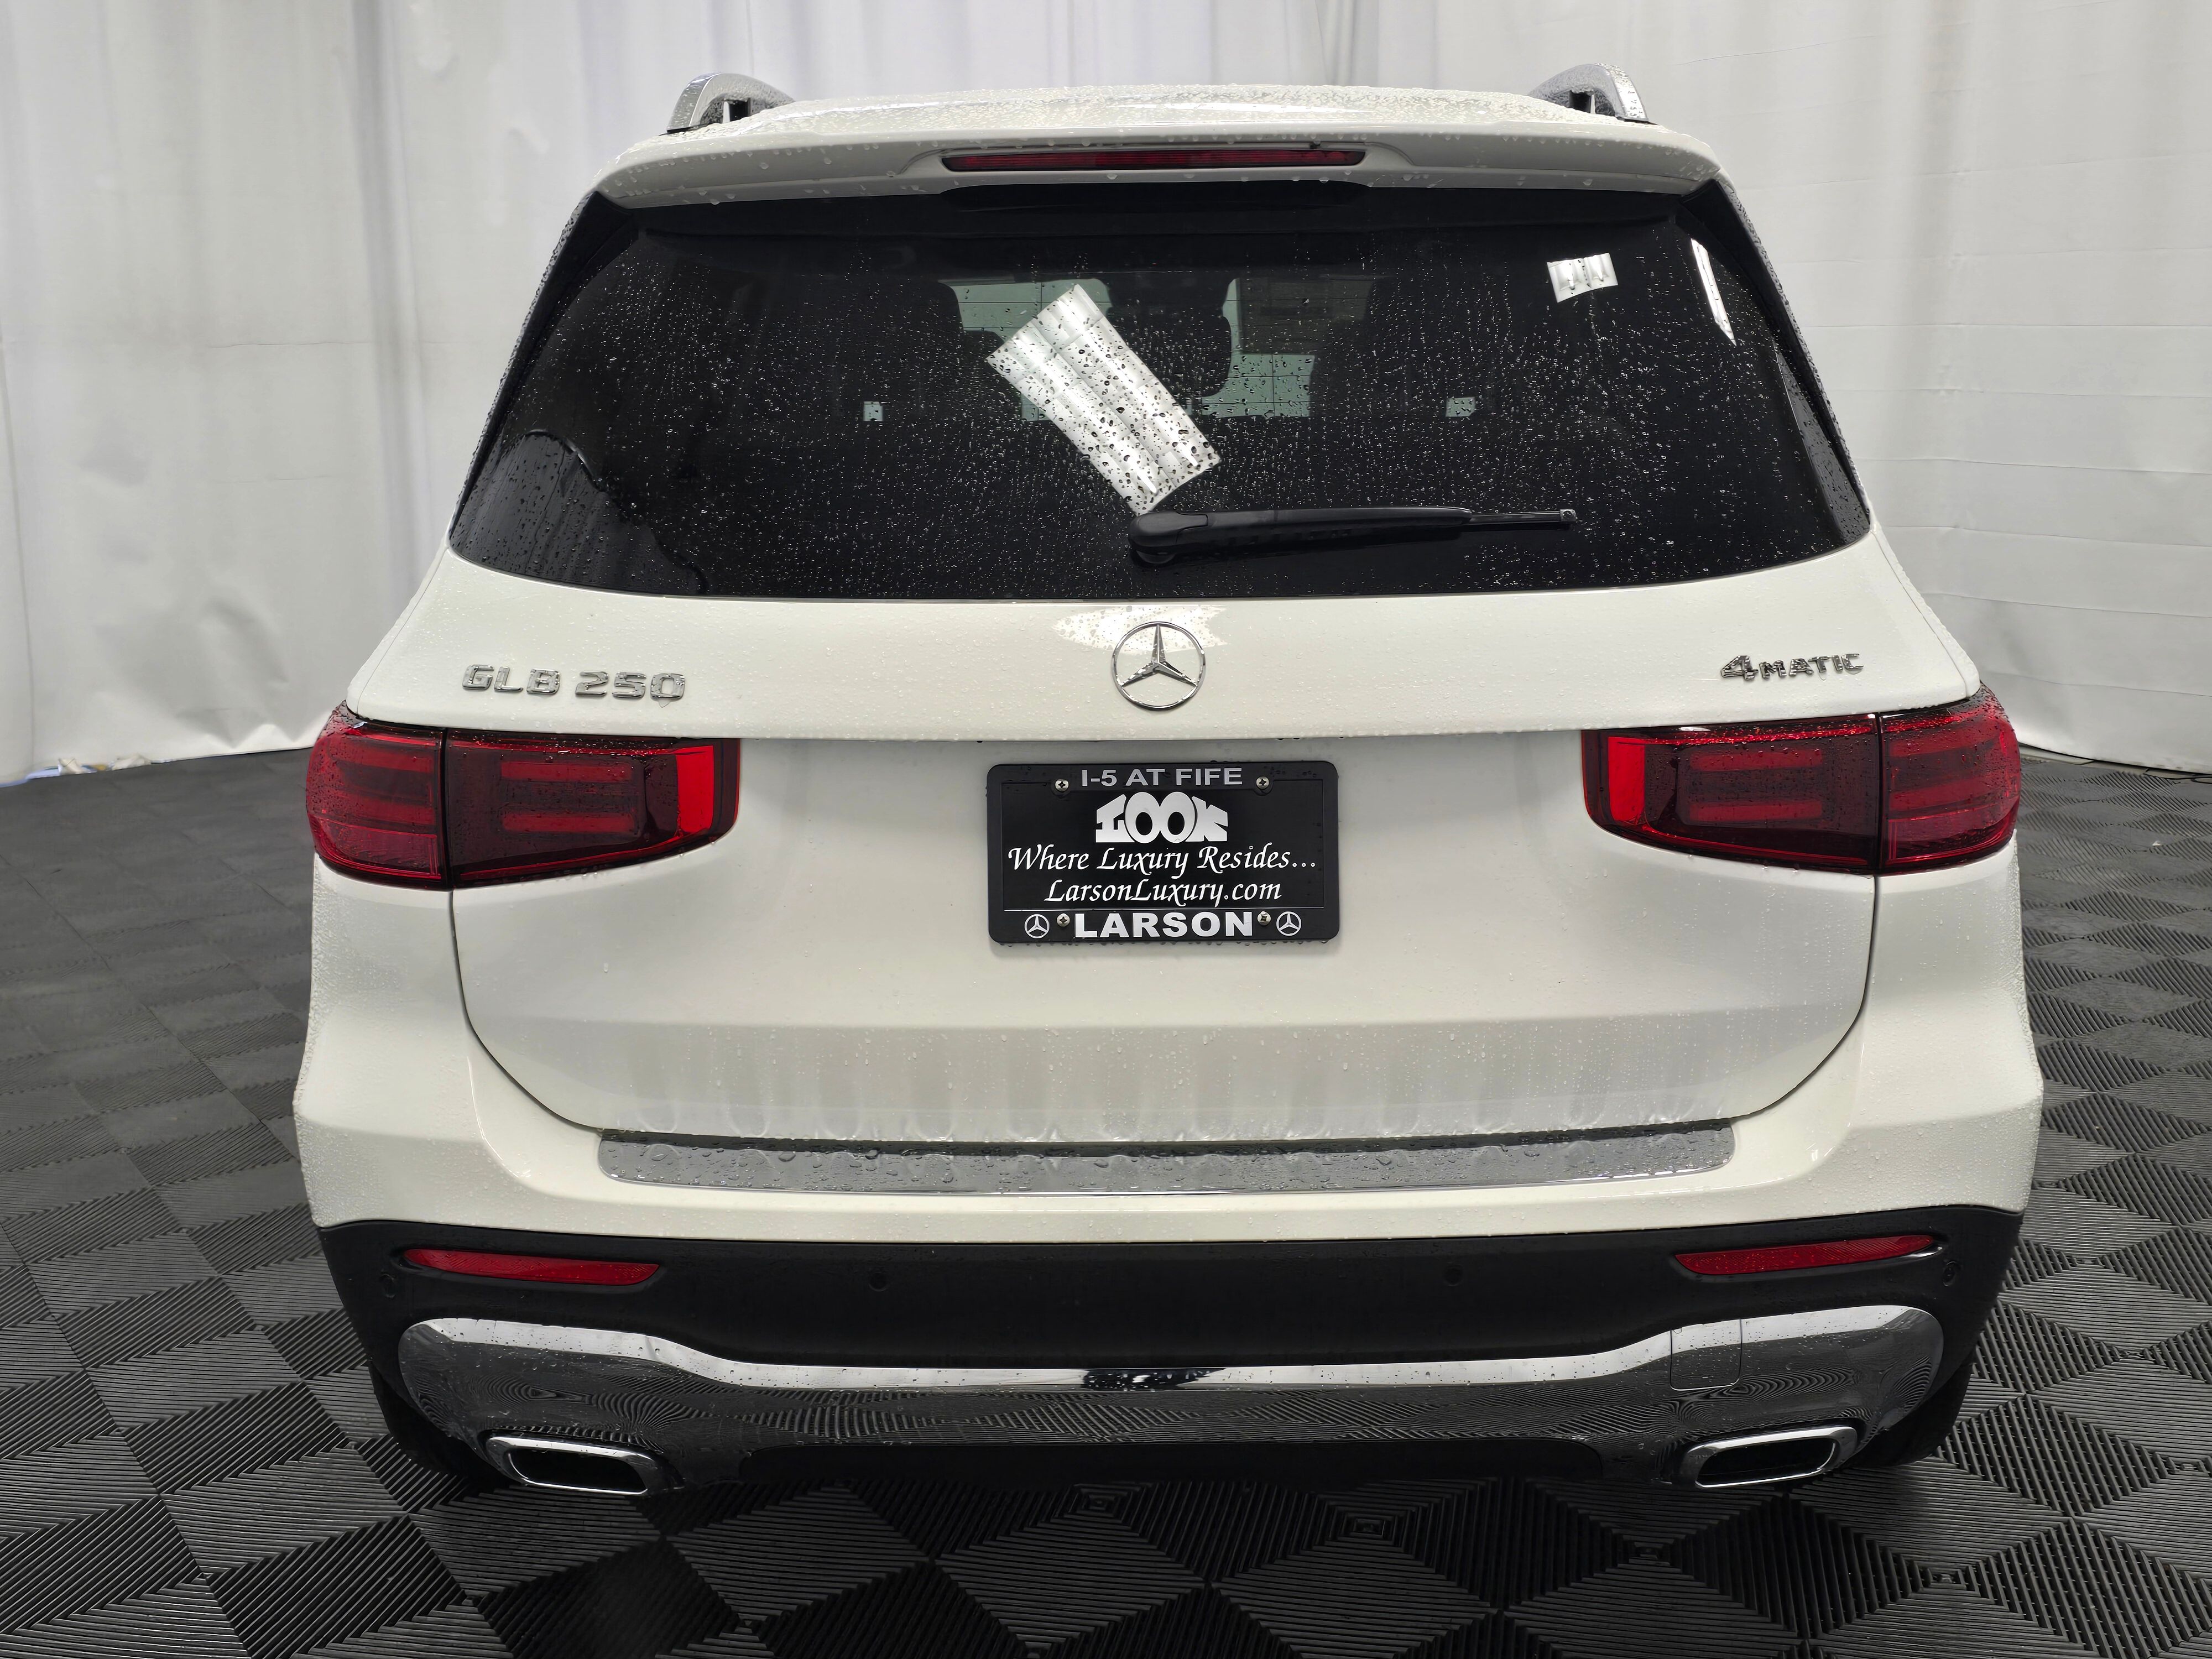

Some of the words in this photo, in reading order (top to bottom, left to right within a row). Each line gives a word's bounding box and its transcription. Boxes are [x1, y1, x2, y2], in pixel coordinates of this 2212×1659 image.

[462, 664, 561, 695] GLB
[575, 671, 686, 699] 250
[1720, 653, 1864, 681] 4MATIC
[1081, 769, 1118, 787] I-5
[1126, 768, 1165, 786] AT
[1176, 768, 1243, 785] FIFE
[1095, 791, 1228, 843] LOOK
[1008, 844, 1089, 870] Where
[1097, 847, 1189, 879] Luxury
[1196, 842, 1316, 873] Resides...
[1044, 878, 1282, 907] LarsonLuxury.com
[1074, 911, 1253, 938] LARSON
